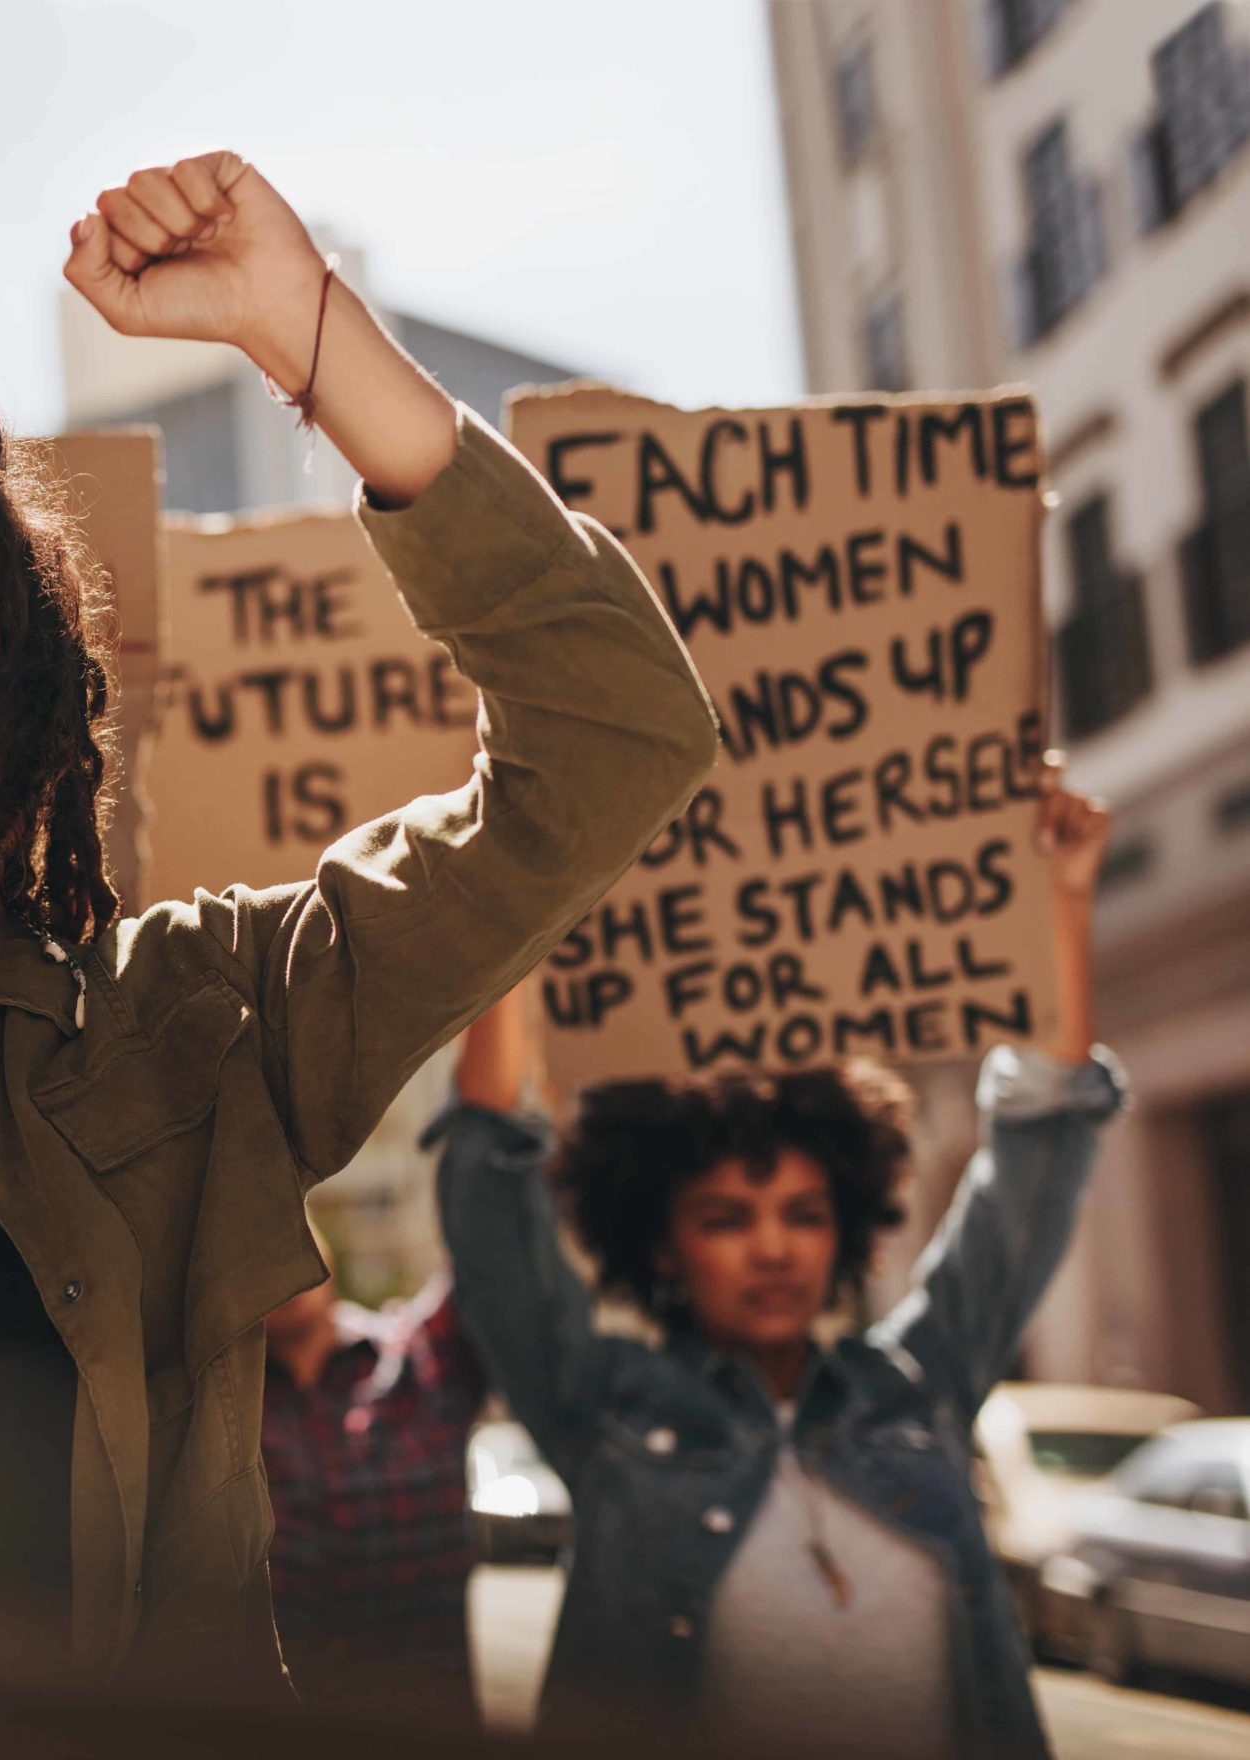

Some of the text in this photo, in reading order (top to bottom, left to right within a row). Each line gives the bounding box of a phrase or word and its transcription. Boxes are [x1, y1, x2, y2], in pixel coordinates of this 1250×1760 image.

[832, 398, 1040, 494] TIME
[198, 562, 367, 646] THE
[658, 523, 962, 640] WOMEN
[890, 609, 994, 703] UP
[261, 760, 347, 844] IS
[550, 838, 1016, 970] SHE STANDS
[543, 936, 1012, 1032] UP FOR ALL
[679, 992, 1034, 1068] WOMEN
